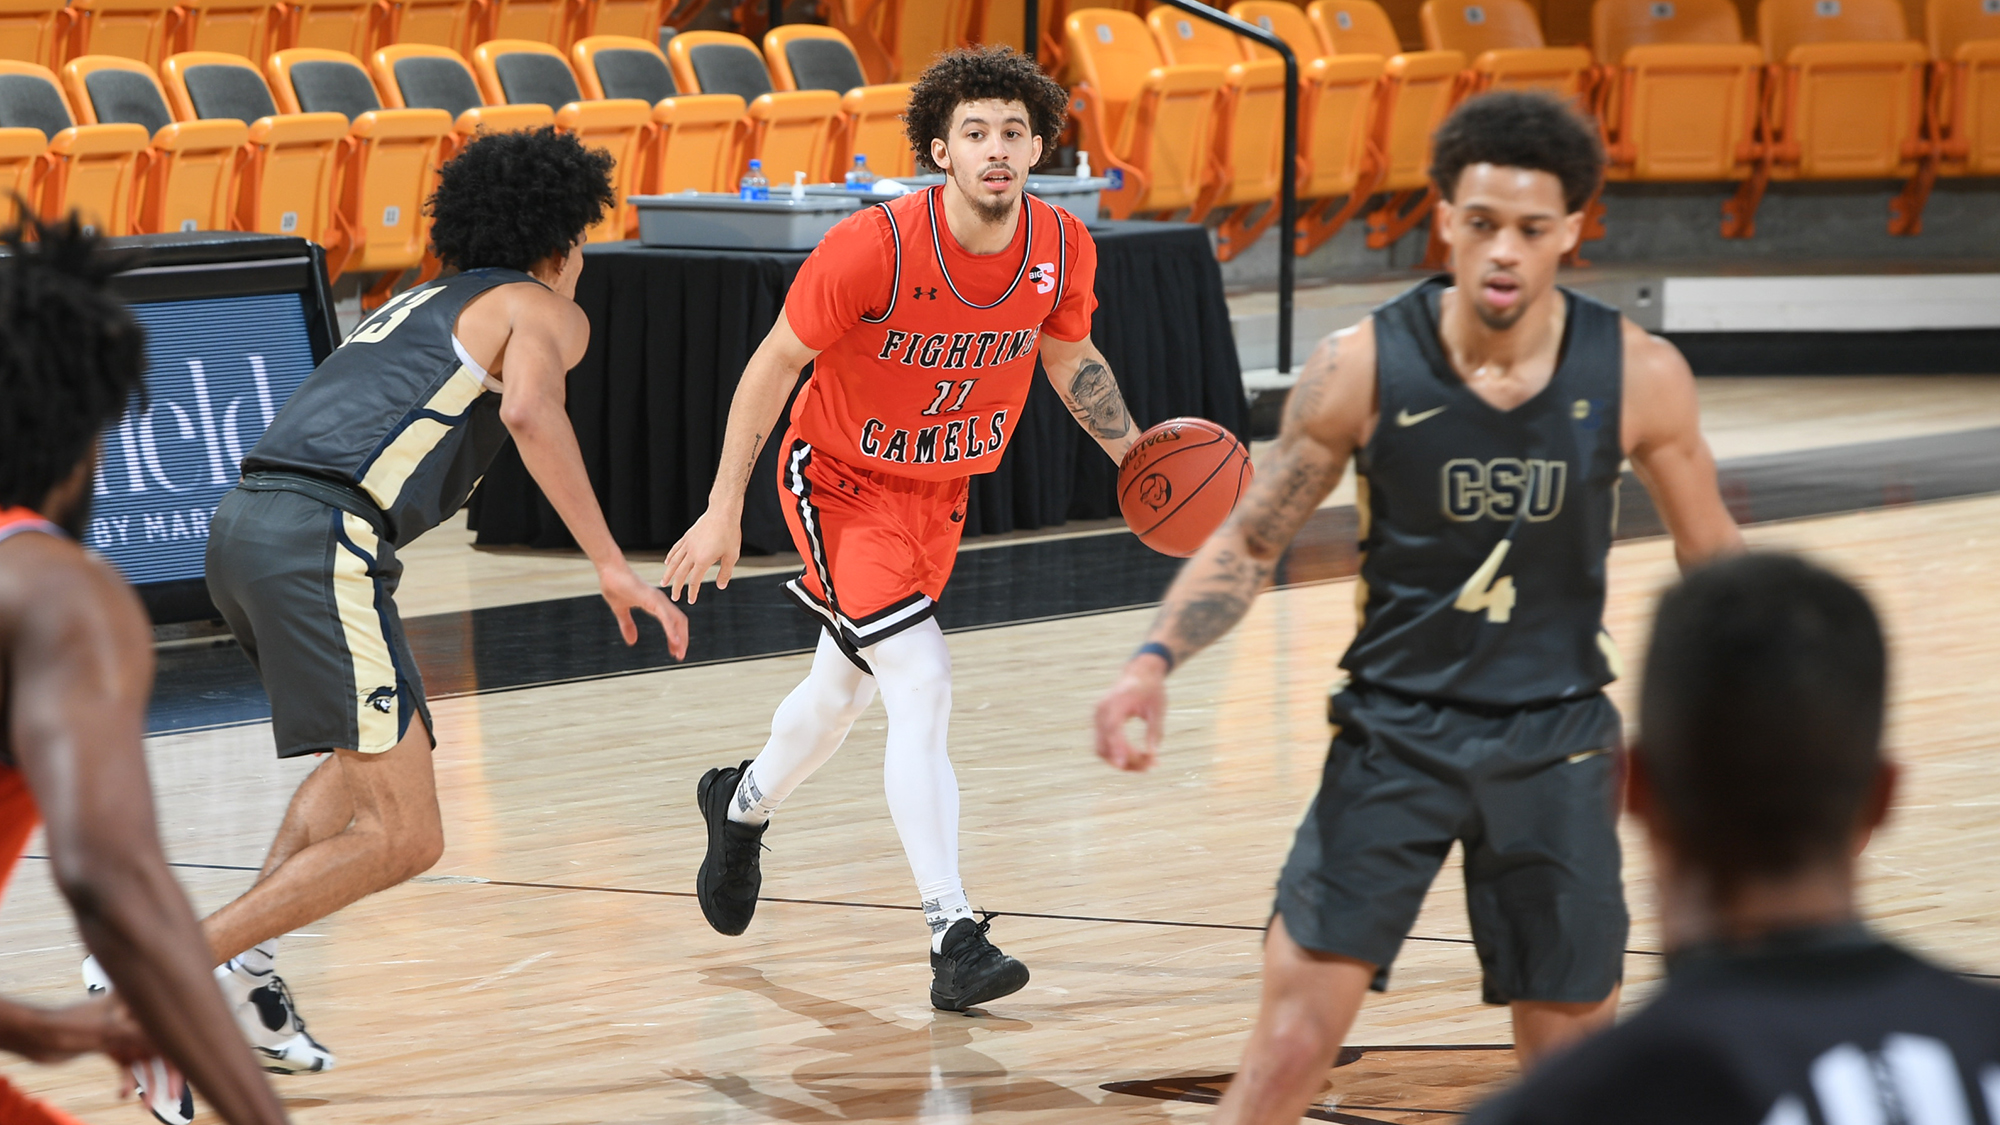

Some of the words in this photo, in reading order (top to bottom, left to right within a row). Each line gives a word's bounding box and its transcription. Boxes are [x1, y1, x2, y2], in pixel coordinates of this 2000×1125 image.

[1028, 270, 1043, 280] BIG
[878, 322, 1043, 369] FIGHTING
[921, 378, 980, 416] 11
[861, 409, 1008, 464] CAMELS
[1441, 458, 1568, 522] CSU
[92, 515, 129, 546] BY
[1453, 538, 1517, 624] 4
